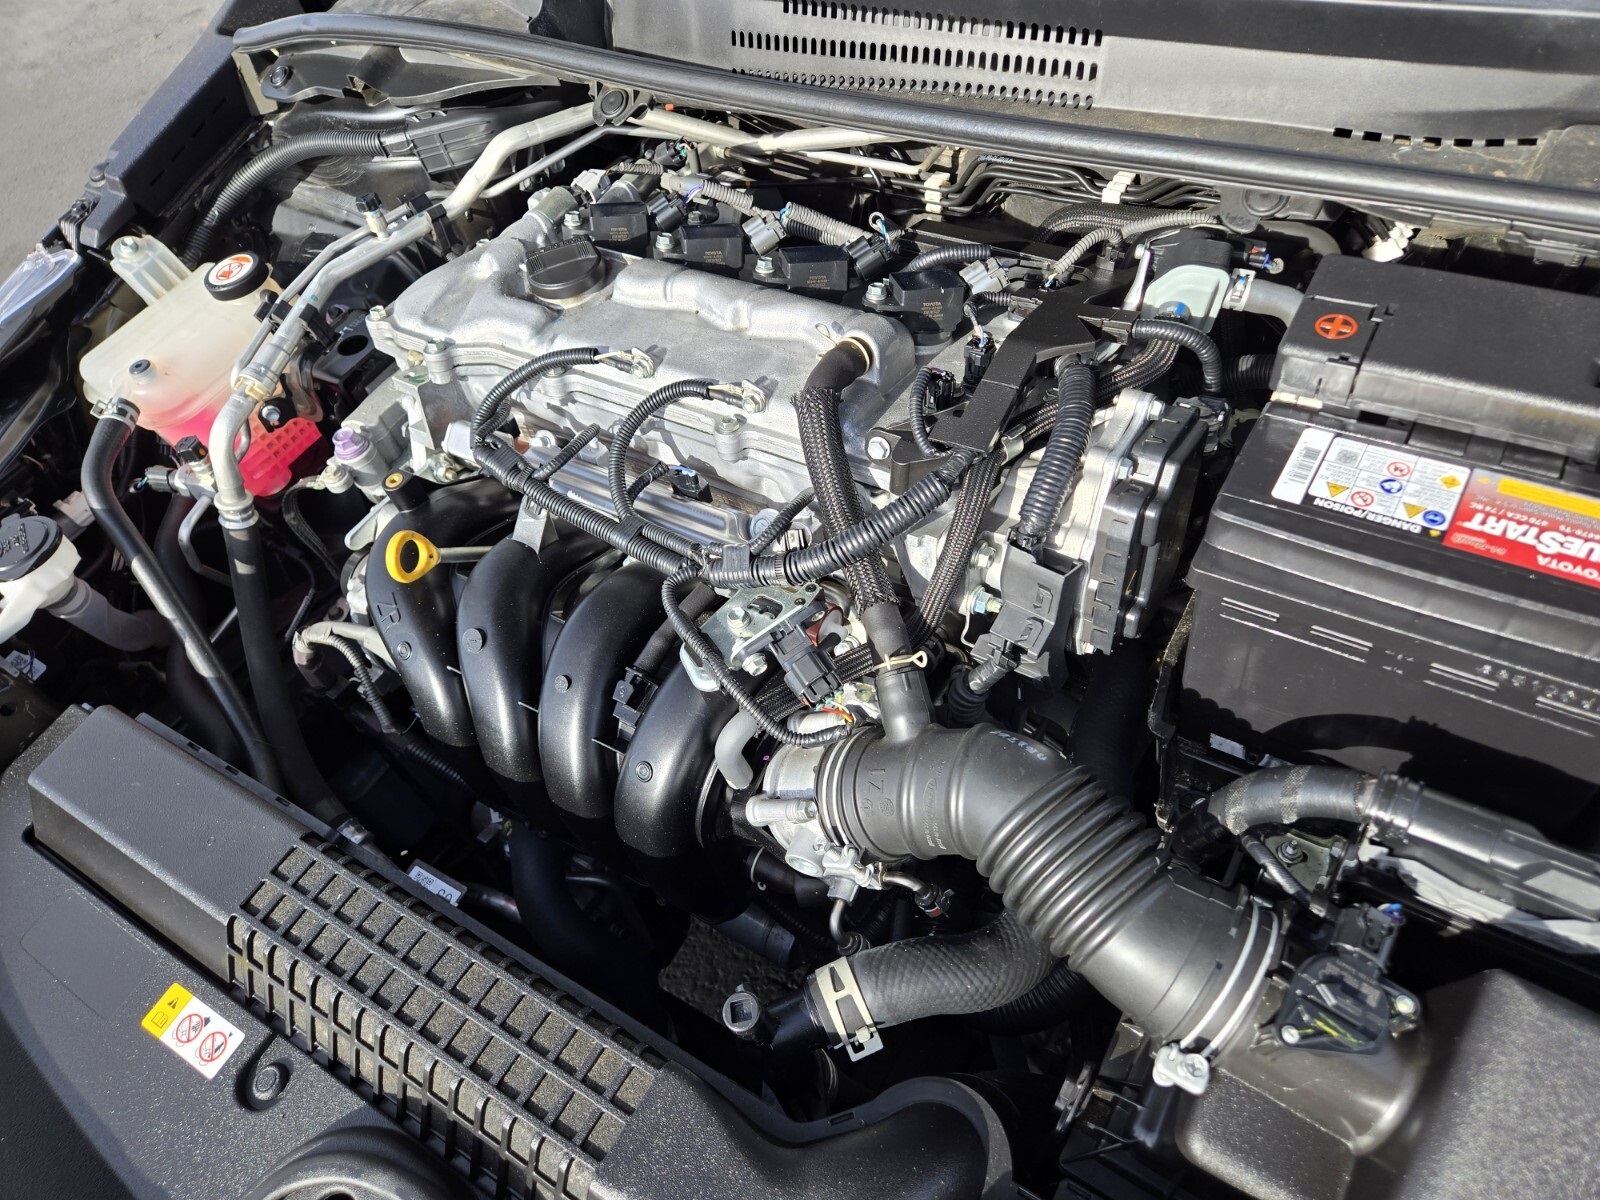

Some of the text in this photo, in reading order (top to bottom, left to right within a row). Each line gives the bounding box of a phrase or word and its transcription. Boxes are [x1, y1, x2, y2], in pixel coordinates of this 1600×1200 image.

[1313, 497, 1422, 534] DANGER/POISON
[1506, 511, 1529, 522] CCA
[377, 591, 402, 633] ZR
